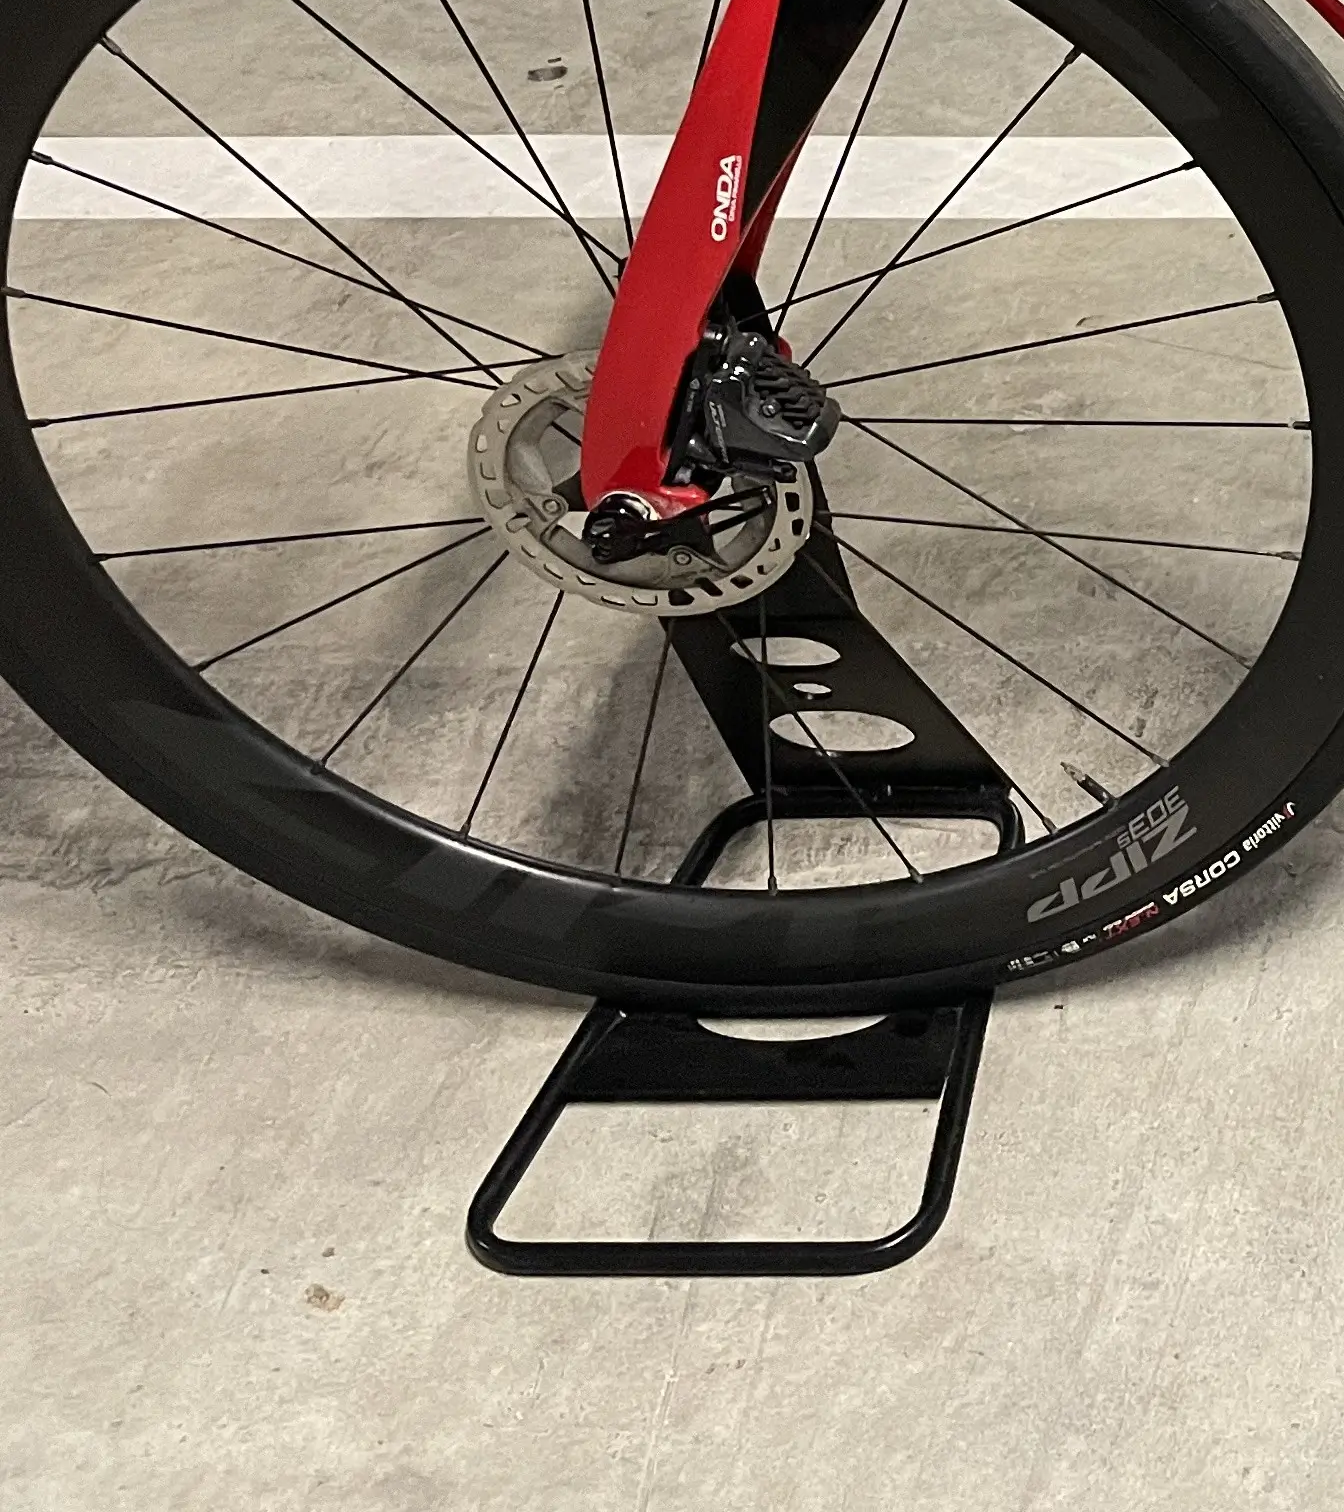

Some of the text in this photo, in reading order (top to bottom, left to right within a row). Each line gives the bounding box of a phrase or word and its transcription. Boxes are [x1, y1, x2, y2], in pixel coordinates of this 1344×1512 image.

[711, 154, 736, 242] ONDA
[1026, 804, 1198, 923] ZIPP
[1162, 849, 1242, 905] CORSA
